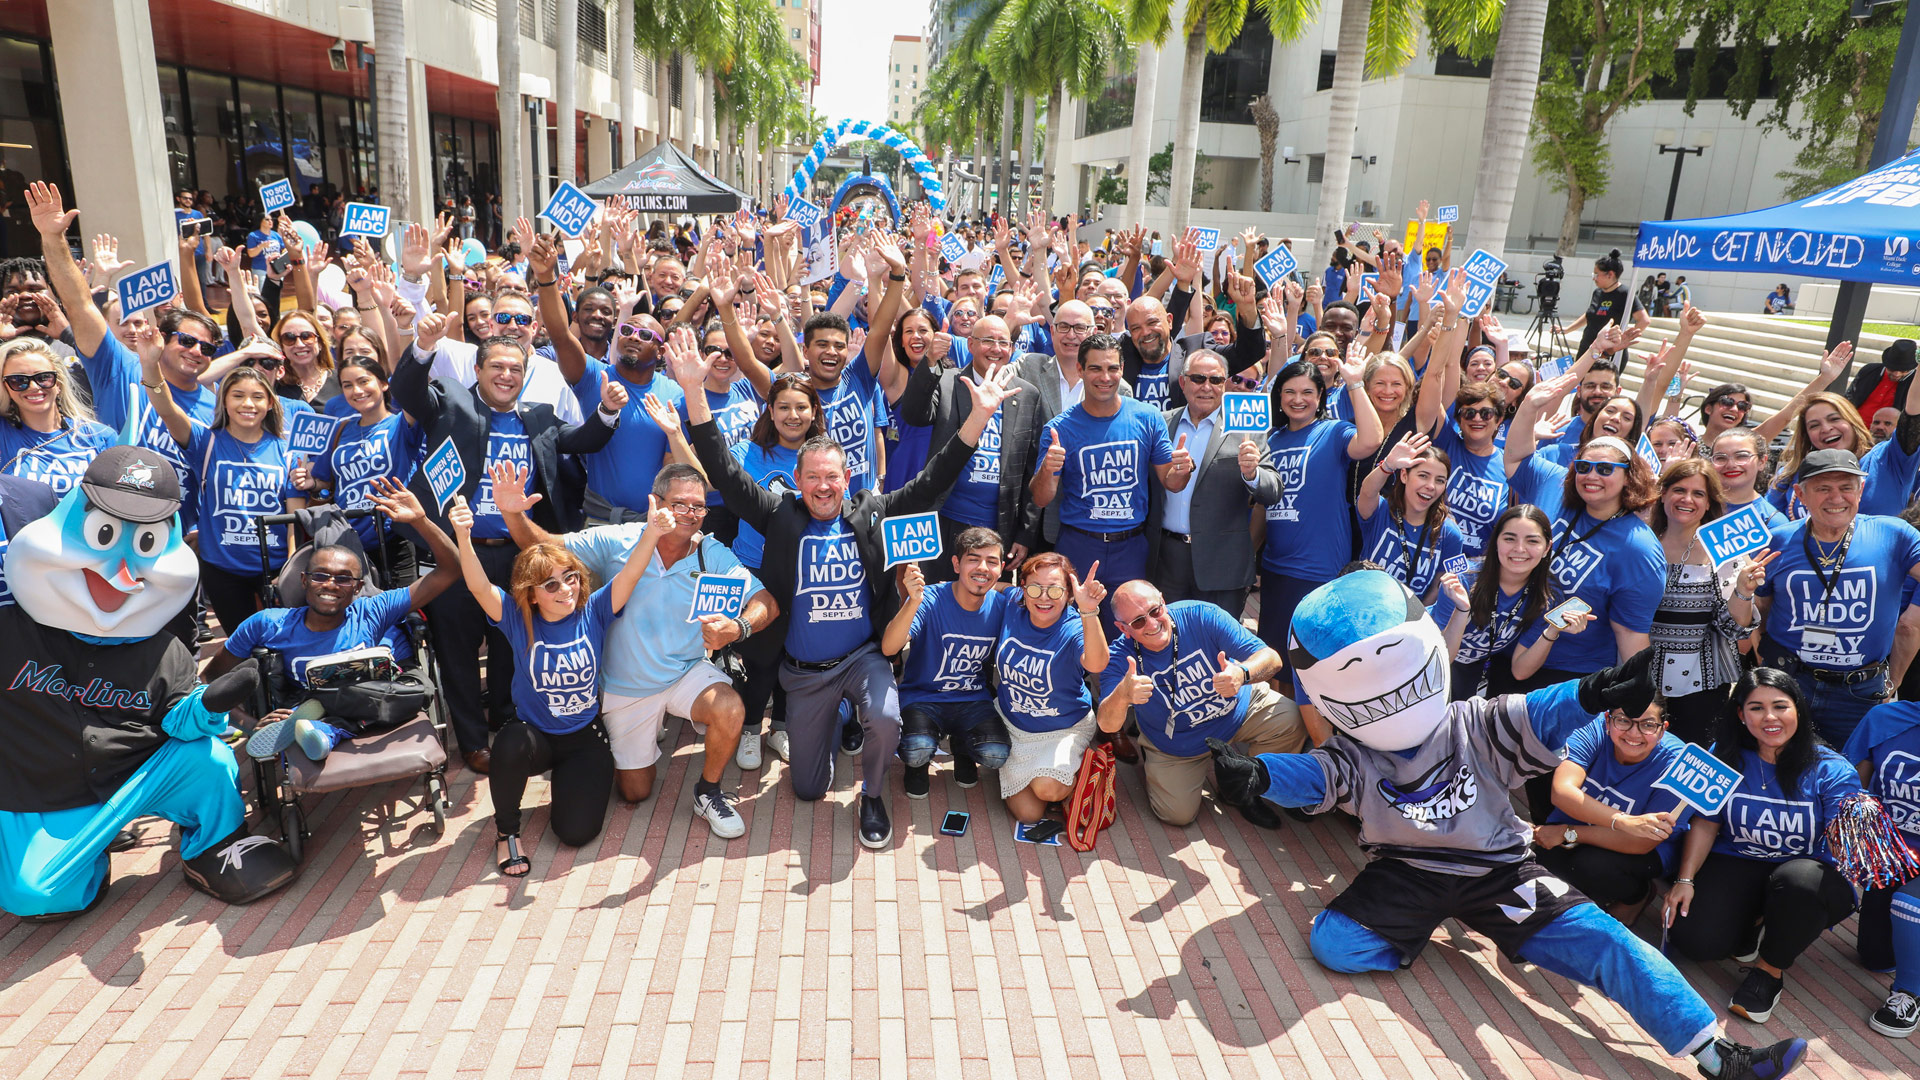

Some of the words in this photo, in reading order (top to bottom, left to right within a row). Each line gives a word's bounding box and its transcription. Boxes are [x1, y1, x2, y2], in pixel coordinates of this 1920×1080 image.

[264, 189, 274, 197] YO
[274, 184, 287, 194] SOY
[266, 192, 291, 208] MDC
[352, 207, 357, 218] I
[362, 208, 384, 222] AM
[560, 190, 568, 202] I
[565, 196, 591, 220] AM
[795, 202, 800, 210] I
[800, 206, 817, 218] AM
[350, 219, 384, 232] MDC
[550, 202, 582, 232] MDC
[790, 209, 813, 226] MDC
[942, 240, 956, 260] MDC
[950, 242, 963, 254] AM
[1197, 240, 1214, 249] DC
[1637, 230, 1701, 262] #BeMDC
[1712, 231, 1754, 262] GET
[1755, 231, 1865, 268] INVOLVED
[1260, 264, 1268, 272] I
[1268, 250, 1287, 268] AM
[1266, 258, 1293, 282] MDC
[1474, 254, 1482, 262] I
[1480, 258, 1501, 274] AM
[126, 281, 132, 295] I
[137, 268, 168, 292] AM
[1466, 262, 1494, 282] MDC
[127, 282, 172, 310] MDC
[1136, 382, 1140, 398] I
[1144, 382, 1170, 398] AM
[832, 402, 861, 427] AM
[1142, 398, 1172, 412] DC
[1230, 399, 1235, 412] I
[1240, 399, 1265, 412] AM
[299, 419, 304, 430] I
[308, 420, 330, 436] AM
[1230, 412, 1266, 427] MDC
[292, 434, 326, 450] MDC
[824, 420, 866, 444] MDC
[978, 432, 1002, 448] MD
[340, 450, 346, 464] I
[350, 439, 382, 462] AM
[487, 440, 492, 456] I
[498, 442, 527, 459] AM
[846, 445, 867, 466] AY
[31, 456, 38, 471] I
[50, 460, 89, 475] AM
[340, 455, 386, 482] MDC
[428, 459, 448, 479] MWEN
[446, 450, 456, 462] SE
[974, 456, 1000, 472] DA
[1090, 454, 1096, 470] I
[1101, 450, 1132, 469] AM
[1277, 454, 1303, 470] AM
[227, 470, 232, 486] I
[239, 472, 276, 490] AM
[434, 460, 461, 498] MDC
[1090, 468, 1135, 486] MDC
[1280, 469, 1300, 486] DC
[224, 488, 276, 508] MDC
[1456, 475, 1466, 488] I
[1465, 482, 1494, 502] AM
[1092, 492, 1133, 510] DAY
[1268, 494, 1298, 510] AY
[1448, 488, 1492, 518] MDC
[224, 516, 271, 534] DA
[892, 525, 898, 539] I
[903, 521, 934, 538] AM
[1458, 519, 1484, 536] AY
[1708, 529, 1718, 544] I
[1722, 514, 1756, 540] AM
[812, 546, 817, 563] I
[824, 542, 860, 563] AM
[892, 538, 936, 558] MDC
[1384, 540, 1394, 558] I
[1714, 528, 1764, 558] MDC
[1452, 558, 1465, 567] AM
[1563, 542, 1590, 570] AM
[810, 561, 862, 583] MDC
[1549, 552, 1577, 586] DC
[700, 583, 729, 596] MWEN
[730, 585, 742, 596] SE
[1802, 580, 1810, 600] I
[1820, 578, 1866, 600] AM
[697, 595, 740, 613] MDC
[811, 590, 862, 610] DAY
[1802, 601, 1867, 623] MDC
[544, 652, 549, 670] I
[556, 648, 590, 672] AM
[948, 643, 954, 656] I
[957, 645, 988, 662] AM
[1006, 648, 1015, 664] I
[1014, 655, 1046, 676] AM
[1812, 654, 1842, 663] SEPT.
[542, 666, 592, 686] MDC
[1003, 664, 1044, 692] MDC
[1176, 660, 1208, 688] AM
[7, 660, 152, 710] Marlins
[1171, 678, 1216, 708] MDC
[546, 684, 594, 708] DAY
[1008, 687, 1050, 710] DAY
[1186, 696, 1230, 722] DAY
[1683, 752, 1718, 779] MWEN
[1715, 773, 1732, 789] SE
[1894, 761, 1906, 780] I
[1670, 761, 1724, 804] MDC
[1890, 779, 1920, 803] MD
[1402, 774, 1478, 822] SHARKS
[1740, 804, 1748, 826] I
[1755, 811, 1804, 834] AM
[1891, 804, 1920, 825] DA
